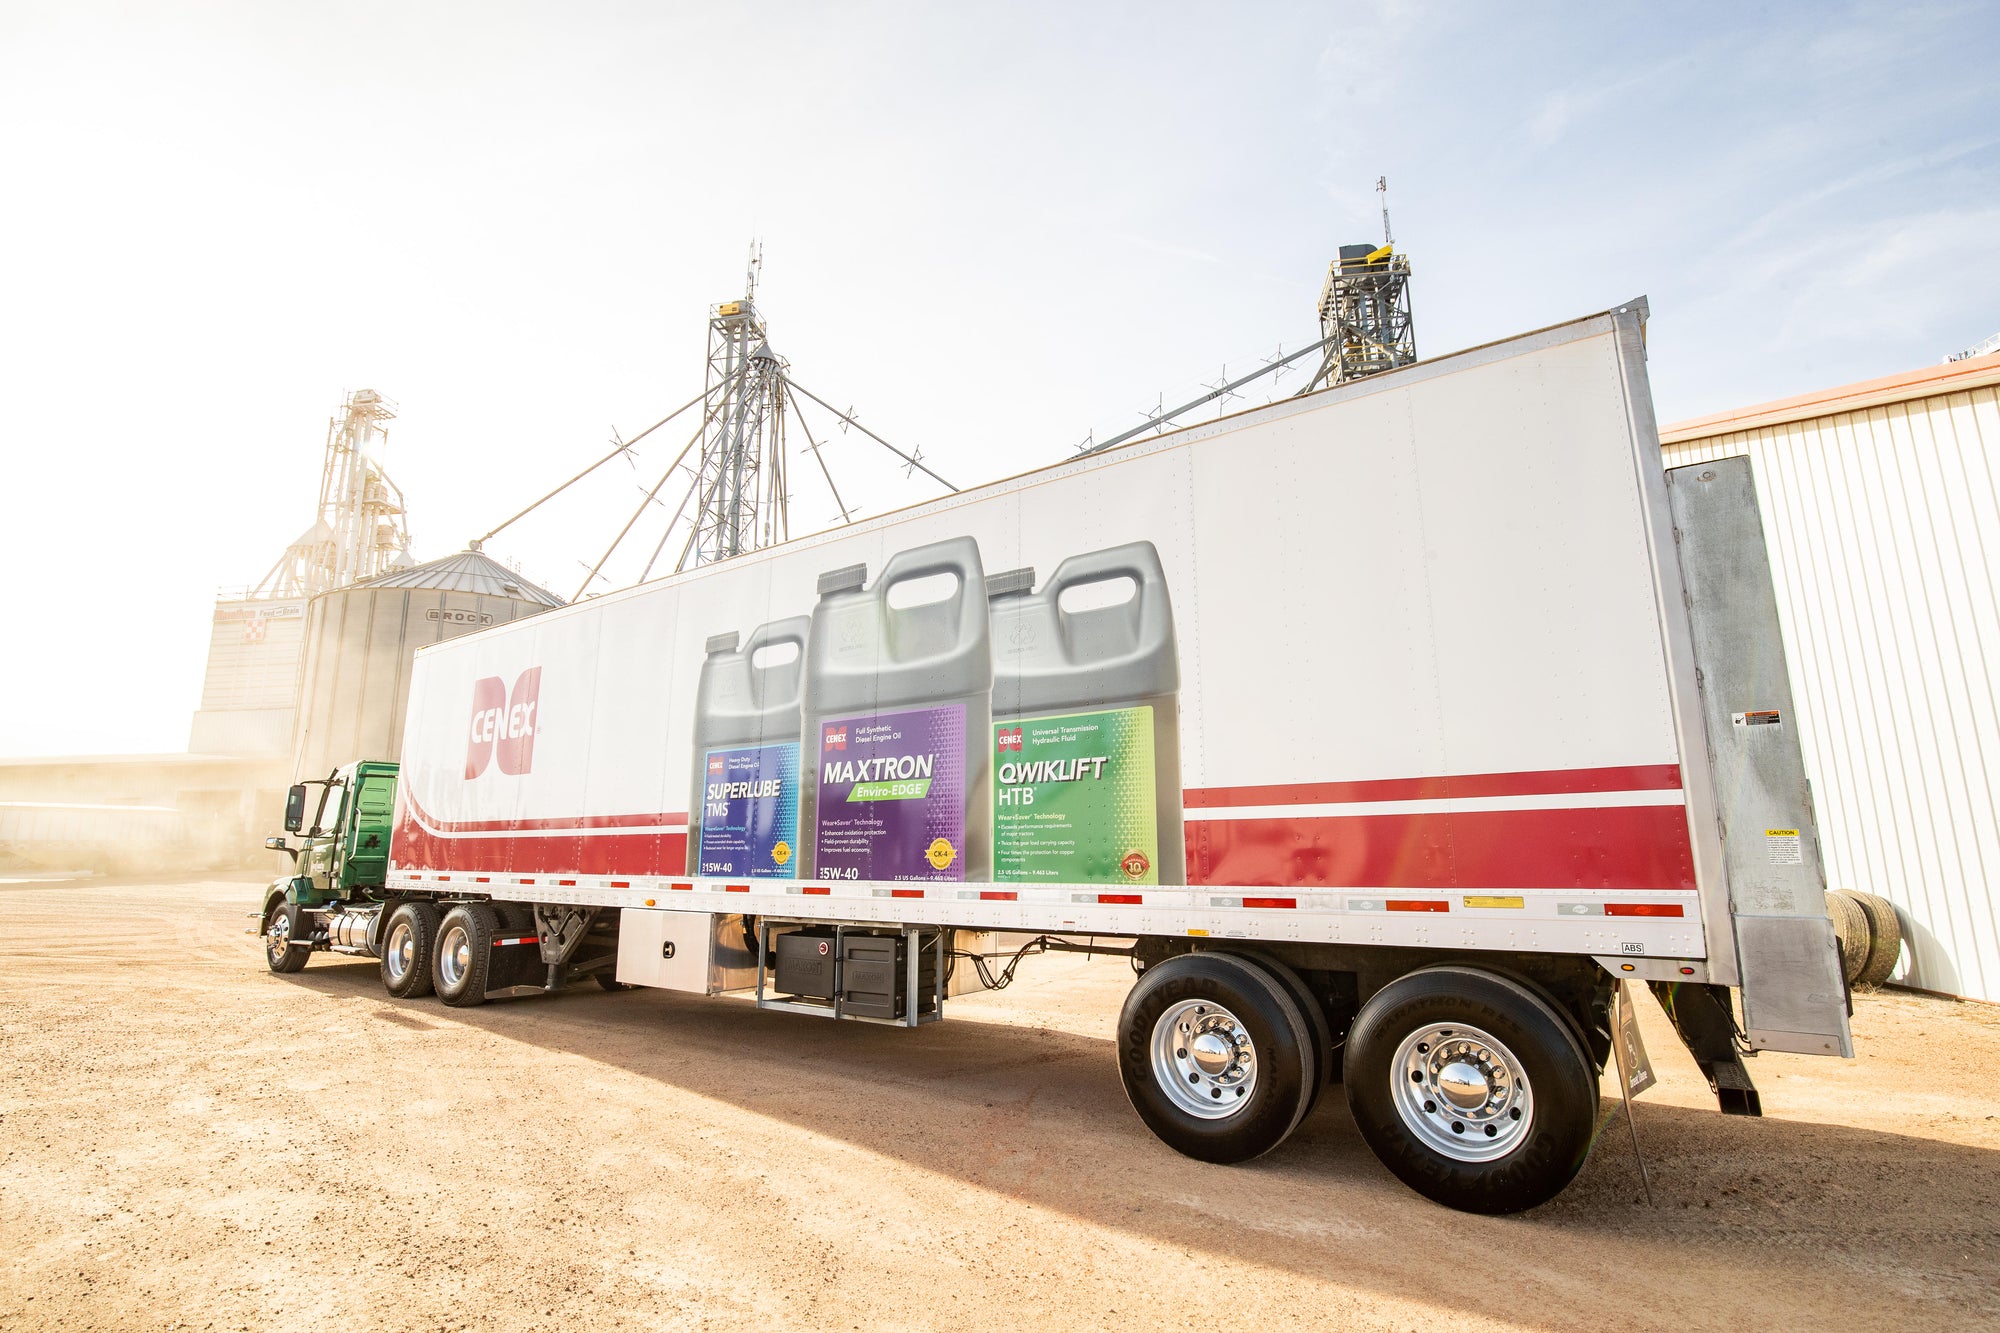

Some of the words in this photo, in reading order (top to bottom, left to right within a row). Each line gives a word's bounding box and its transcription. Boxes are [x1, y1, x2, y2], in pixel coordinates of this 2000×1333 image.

[429, 611, 489, 623] BROCK
[472, 701, 535, 743] CENEX
[866, 725, 891, 735] Synthetic
[1032, 728, 1059, 736] Universal
[1060, 725, 1098, 733] Transmission
[826, 734, 846, 744] CENEX
[855, 736, 872, 744] Diesel
[873, 734, 891, 743] Engine
[999, 735, 1022, 745] CENEX
[1032, 737, 1060, 745] Hydraulic
[823, 753, 934, 784] MAXTRON
[998, 757, 1107, 785] QWIKLIFT
[707, 779, 781, 800] SUPERLUBE
[857, 783, 922, 798] Enviro-EDGE
[999, 787, 1034, 806] HTB
[707, 802, 728, 816] TMS
[1034, 812, 1066, 821] Technology
[705, 862, 732, 873] 15W-40
[823, 868, 858, 880] 5W-40
[1625, 944, 1642, 952] ABS
